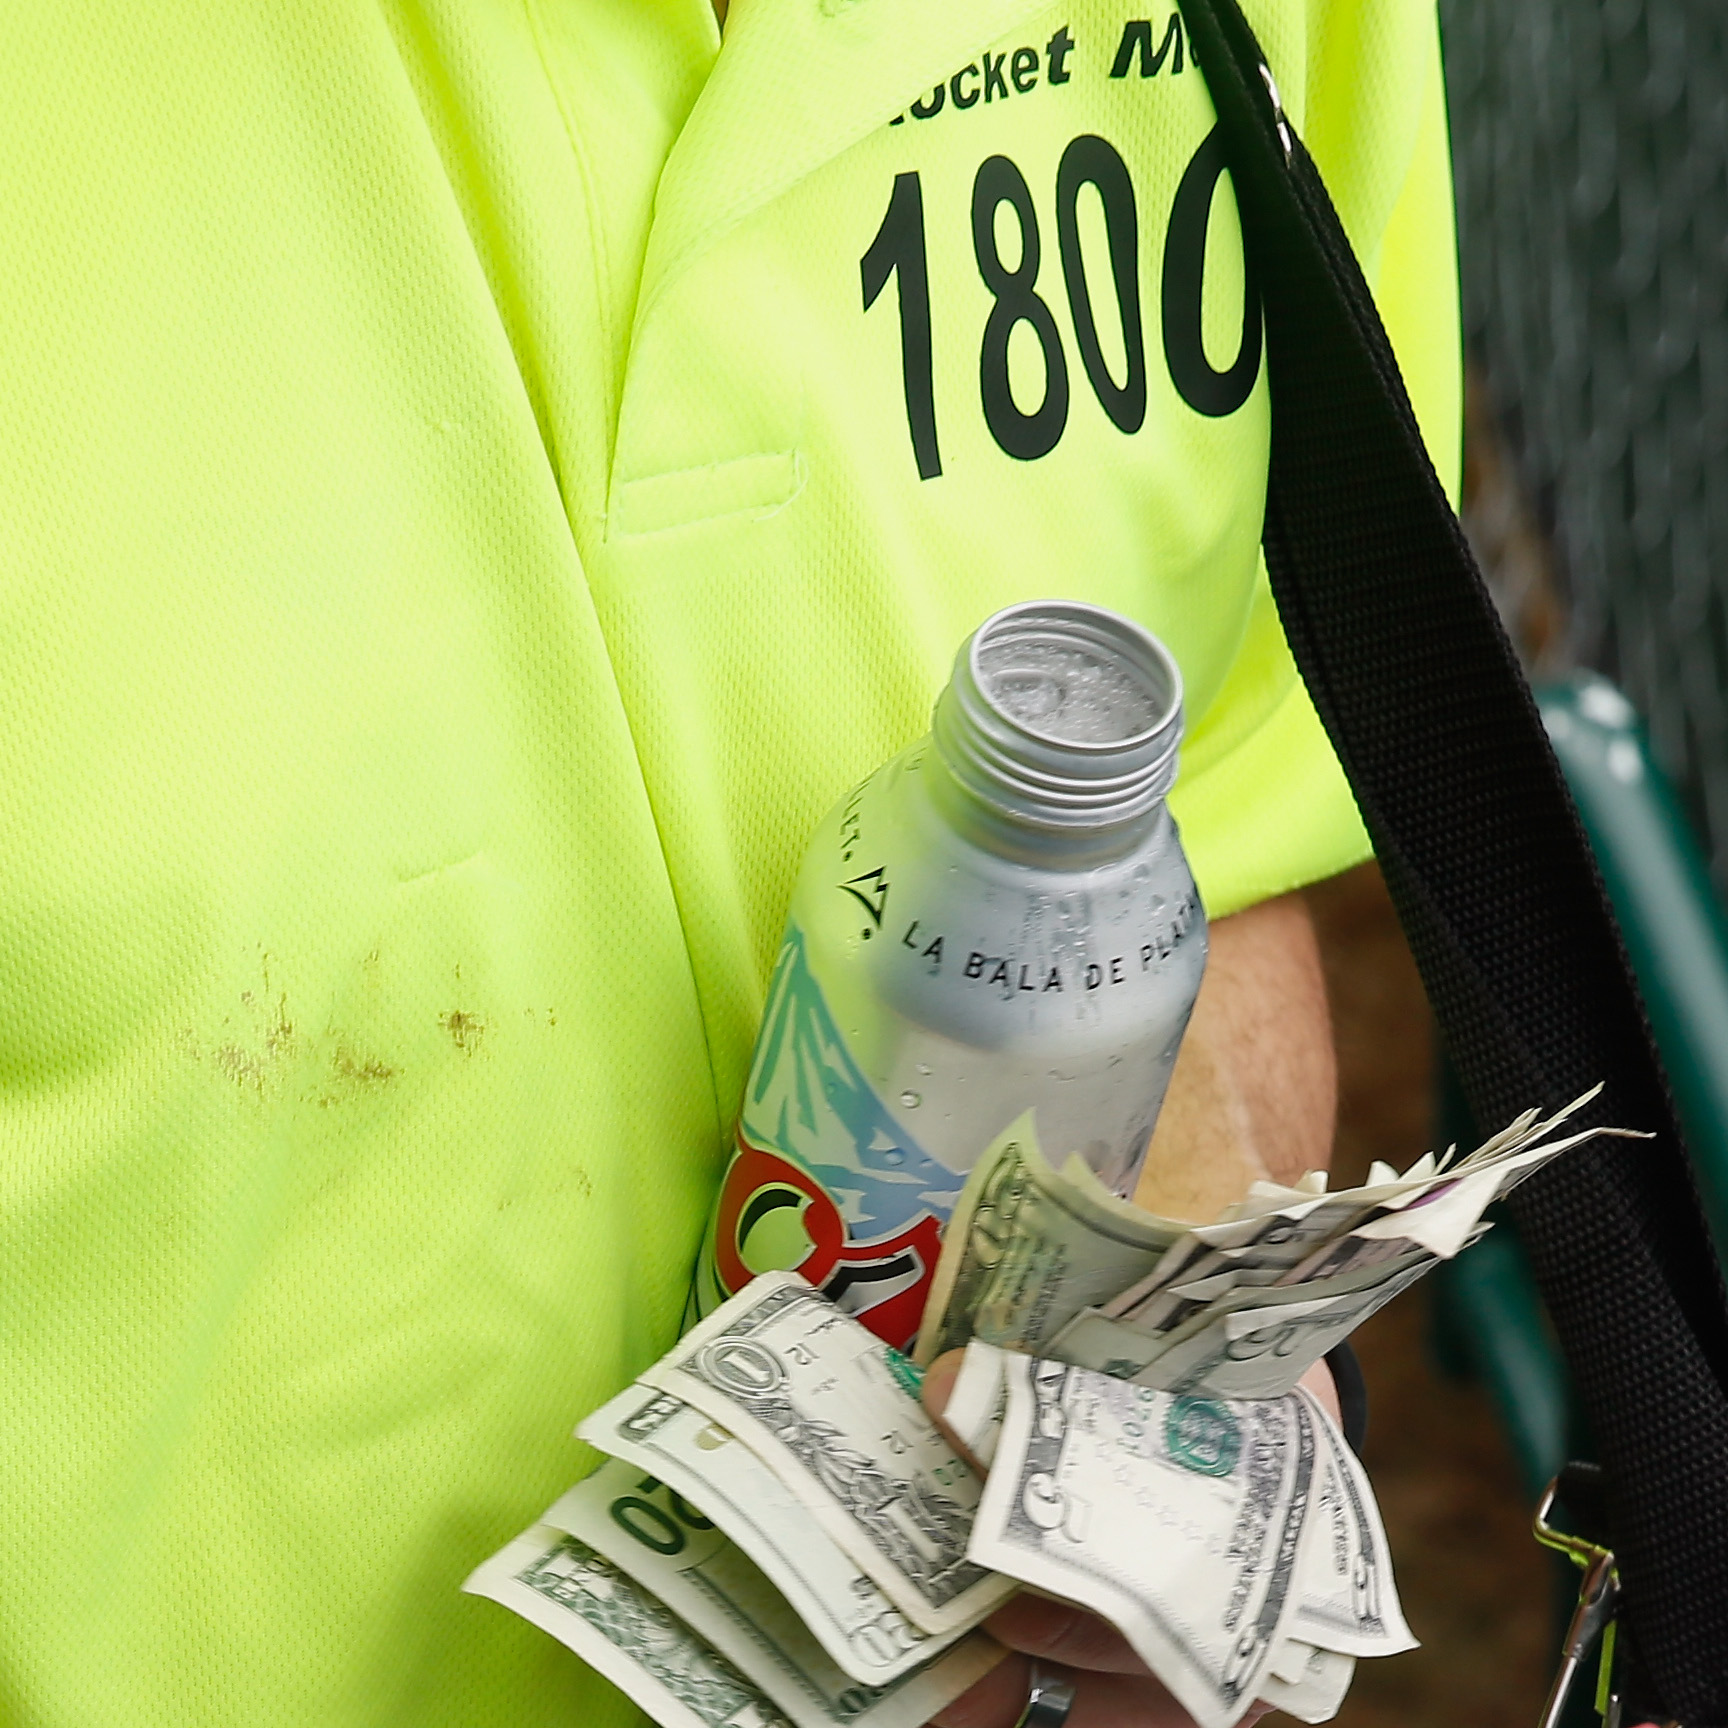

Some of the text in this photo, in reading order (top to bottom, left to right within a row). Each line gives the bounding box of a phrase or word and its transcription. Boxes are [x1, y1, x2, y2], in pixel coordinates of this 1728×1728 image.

[889, 26, 1075, 126] ocket
[859, 133, 1266, 480] 1800
[901, 921, 943, 964] LA
[964, 955, 1065, 992] BALA
[1085, 960, 1123, 990] DE
